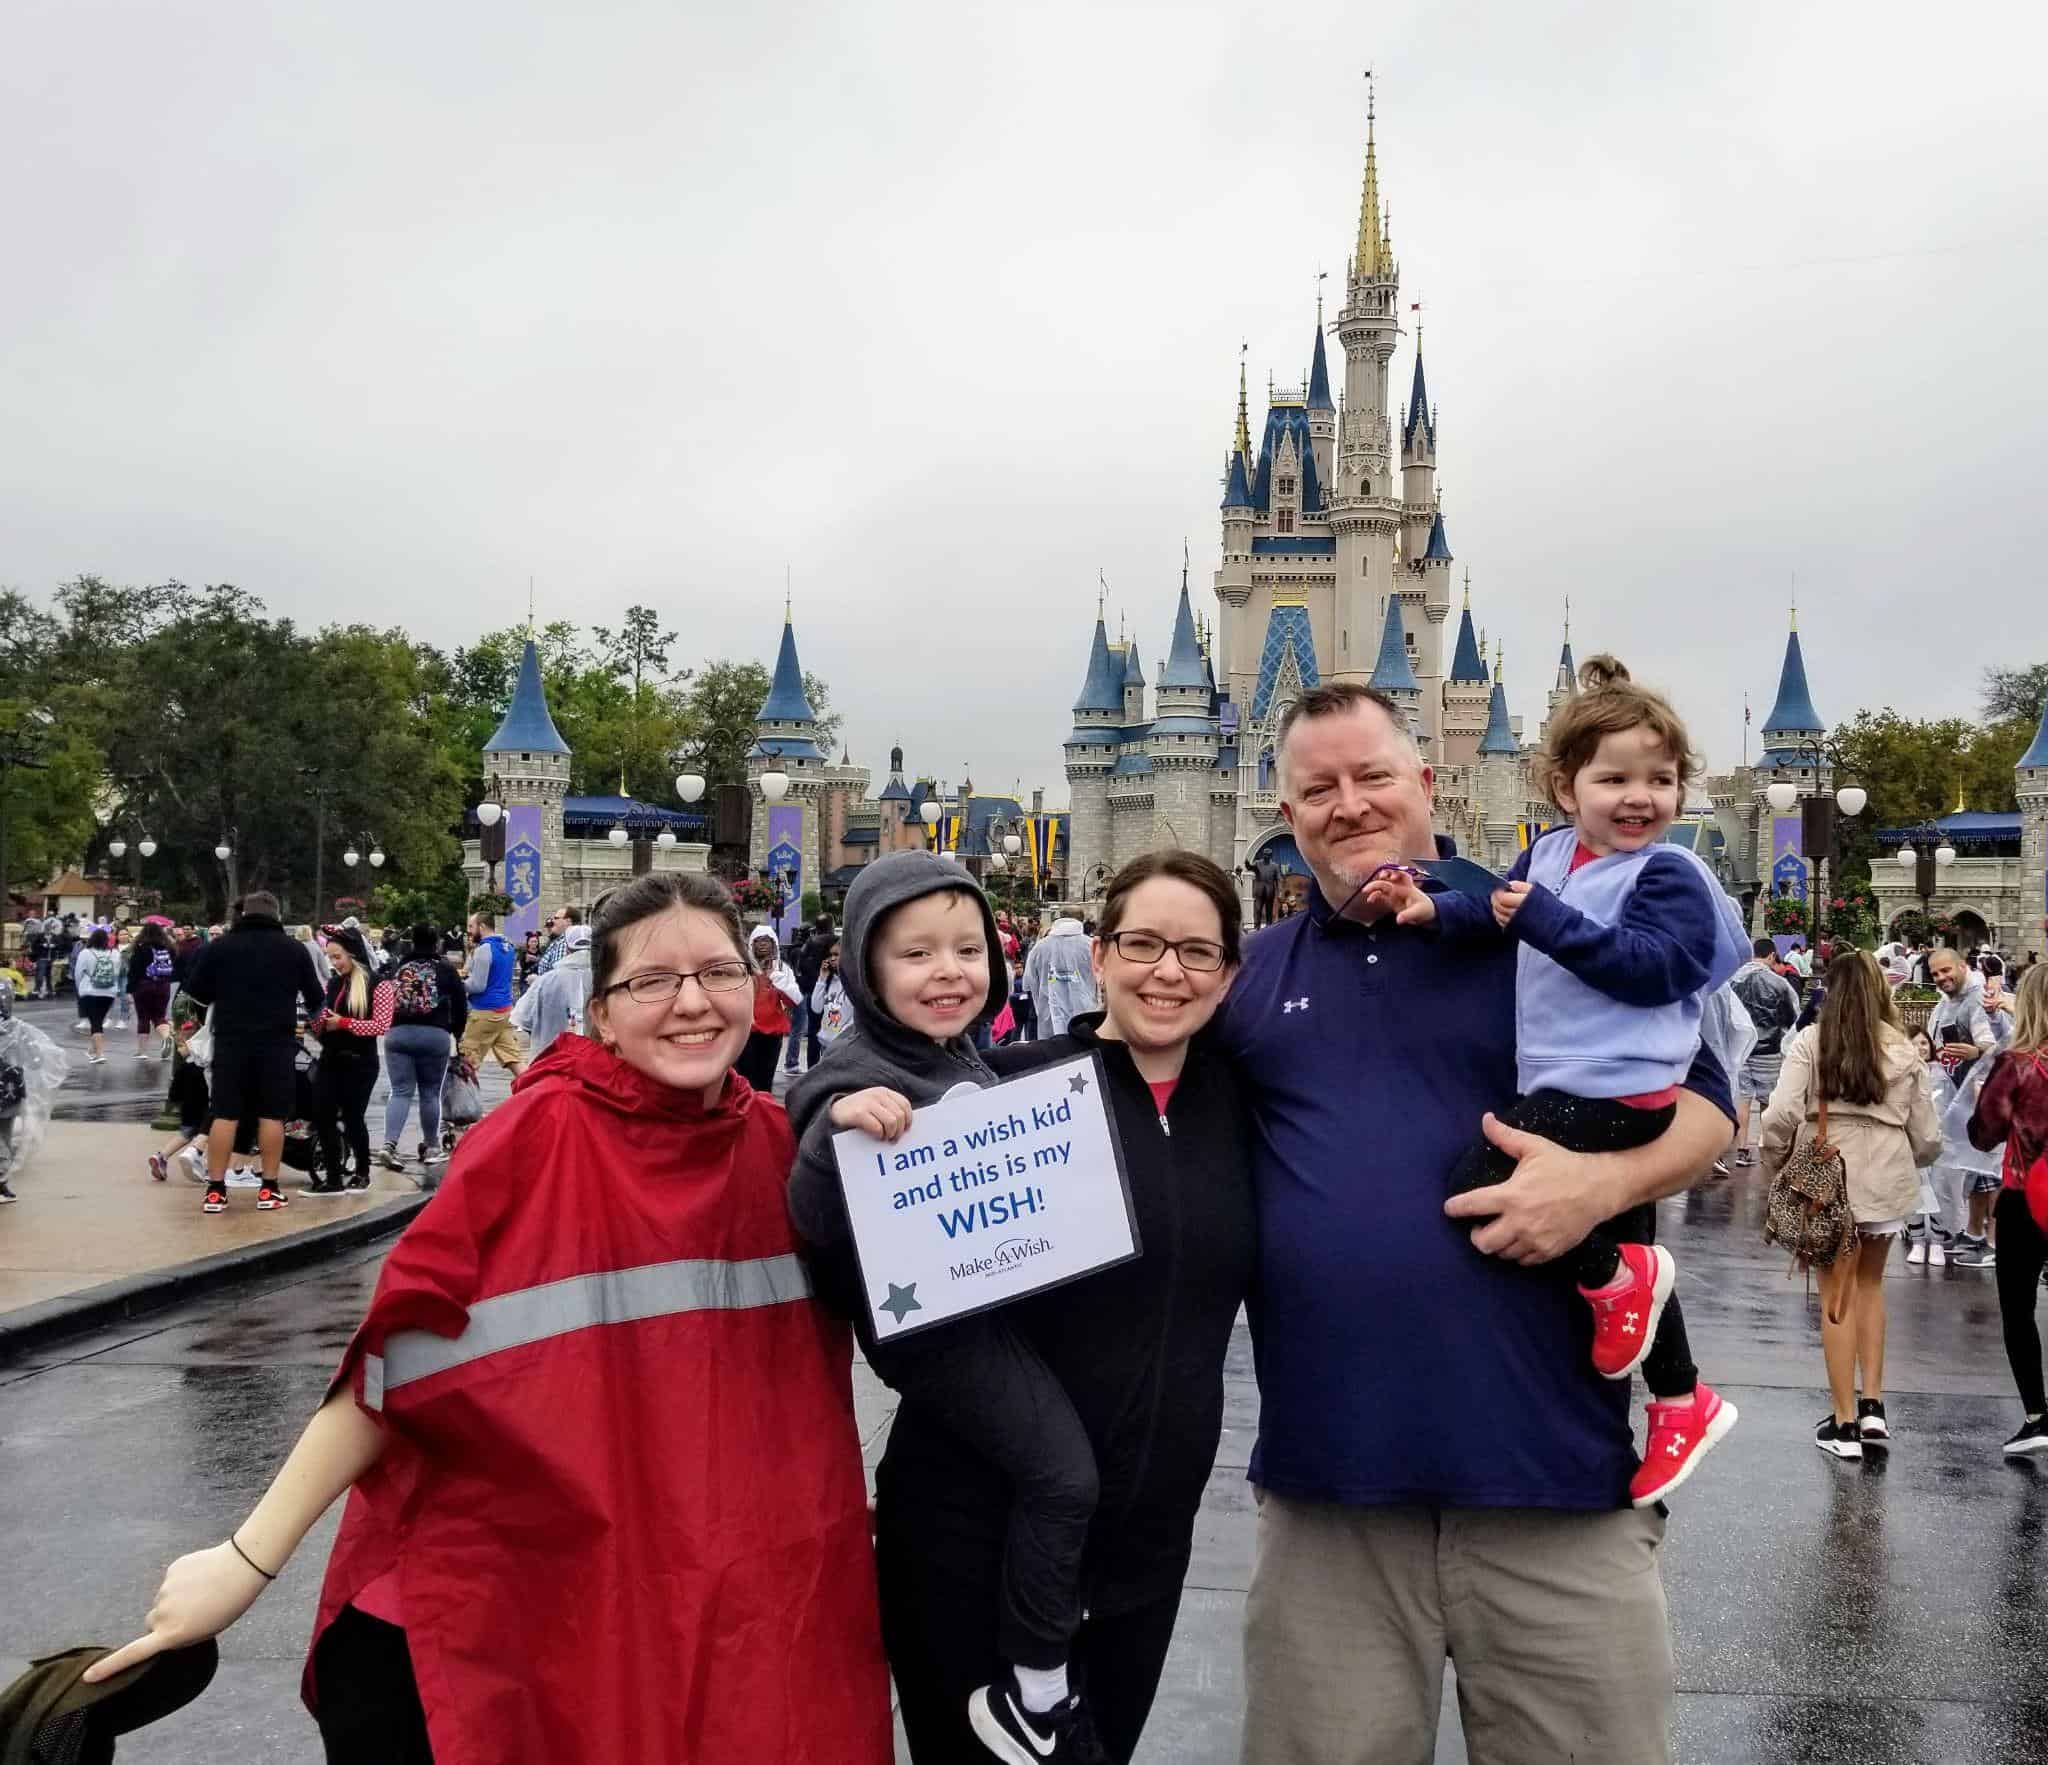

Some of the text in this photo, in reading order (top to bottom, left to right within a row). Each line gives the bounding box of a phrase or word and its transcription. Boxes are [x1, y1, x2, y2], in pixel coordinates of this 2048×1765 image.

[876, 1097, 1072, 1177] I am a wish kid
[892, 1139, 1073, 1210] and this is my
[936, 1186, 1047, 1240] WISH!
